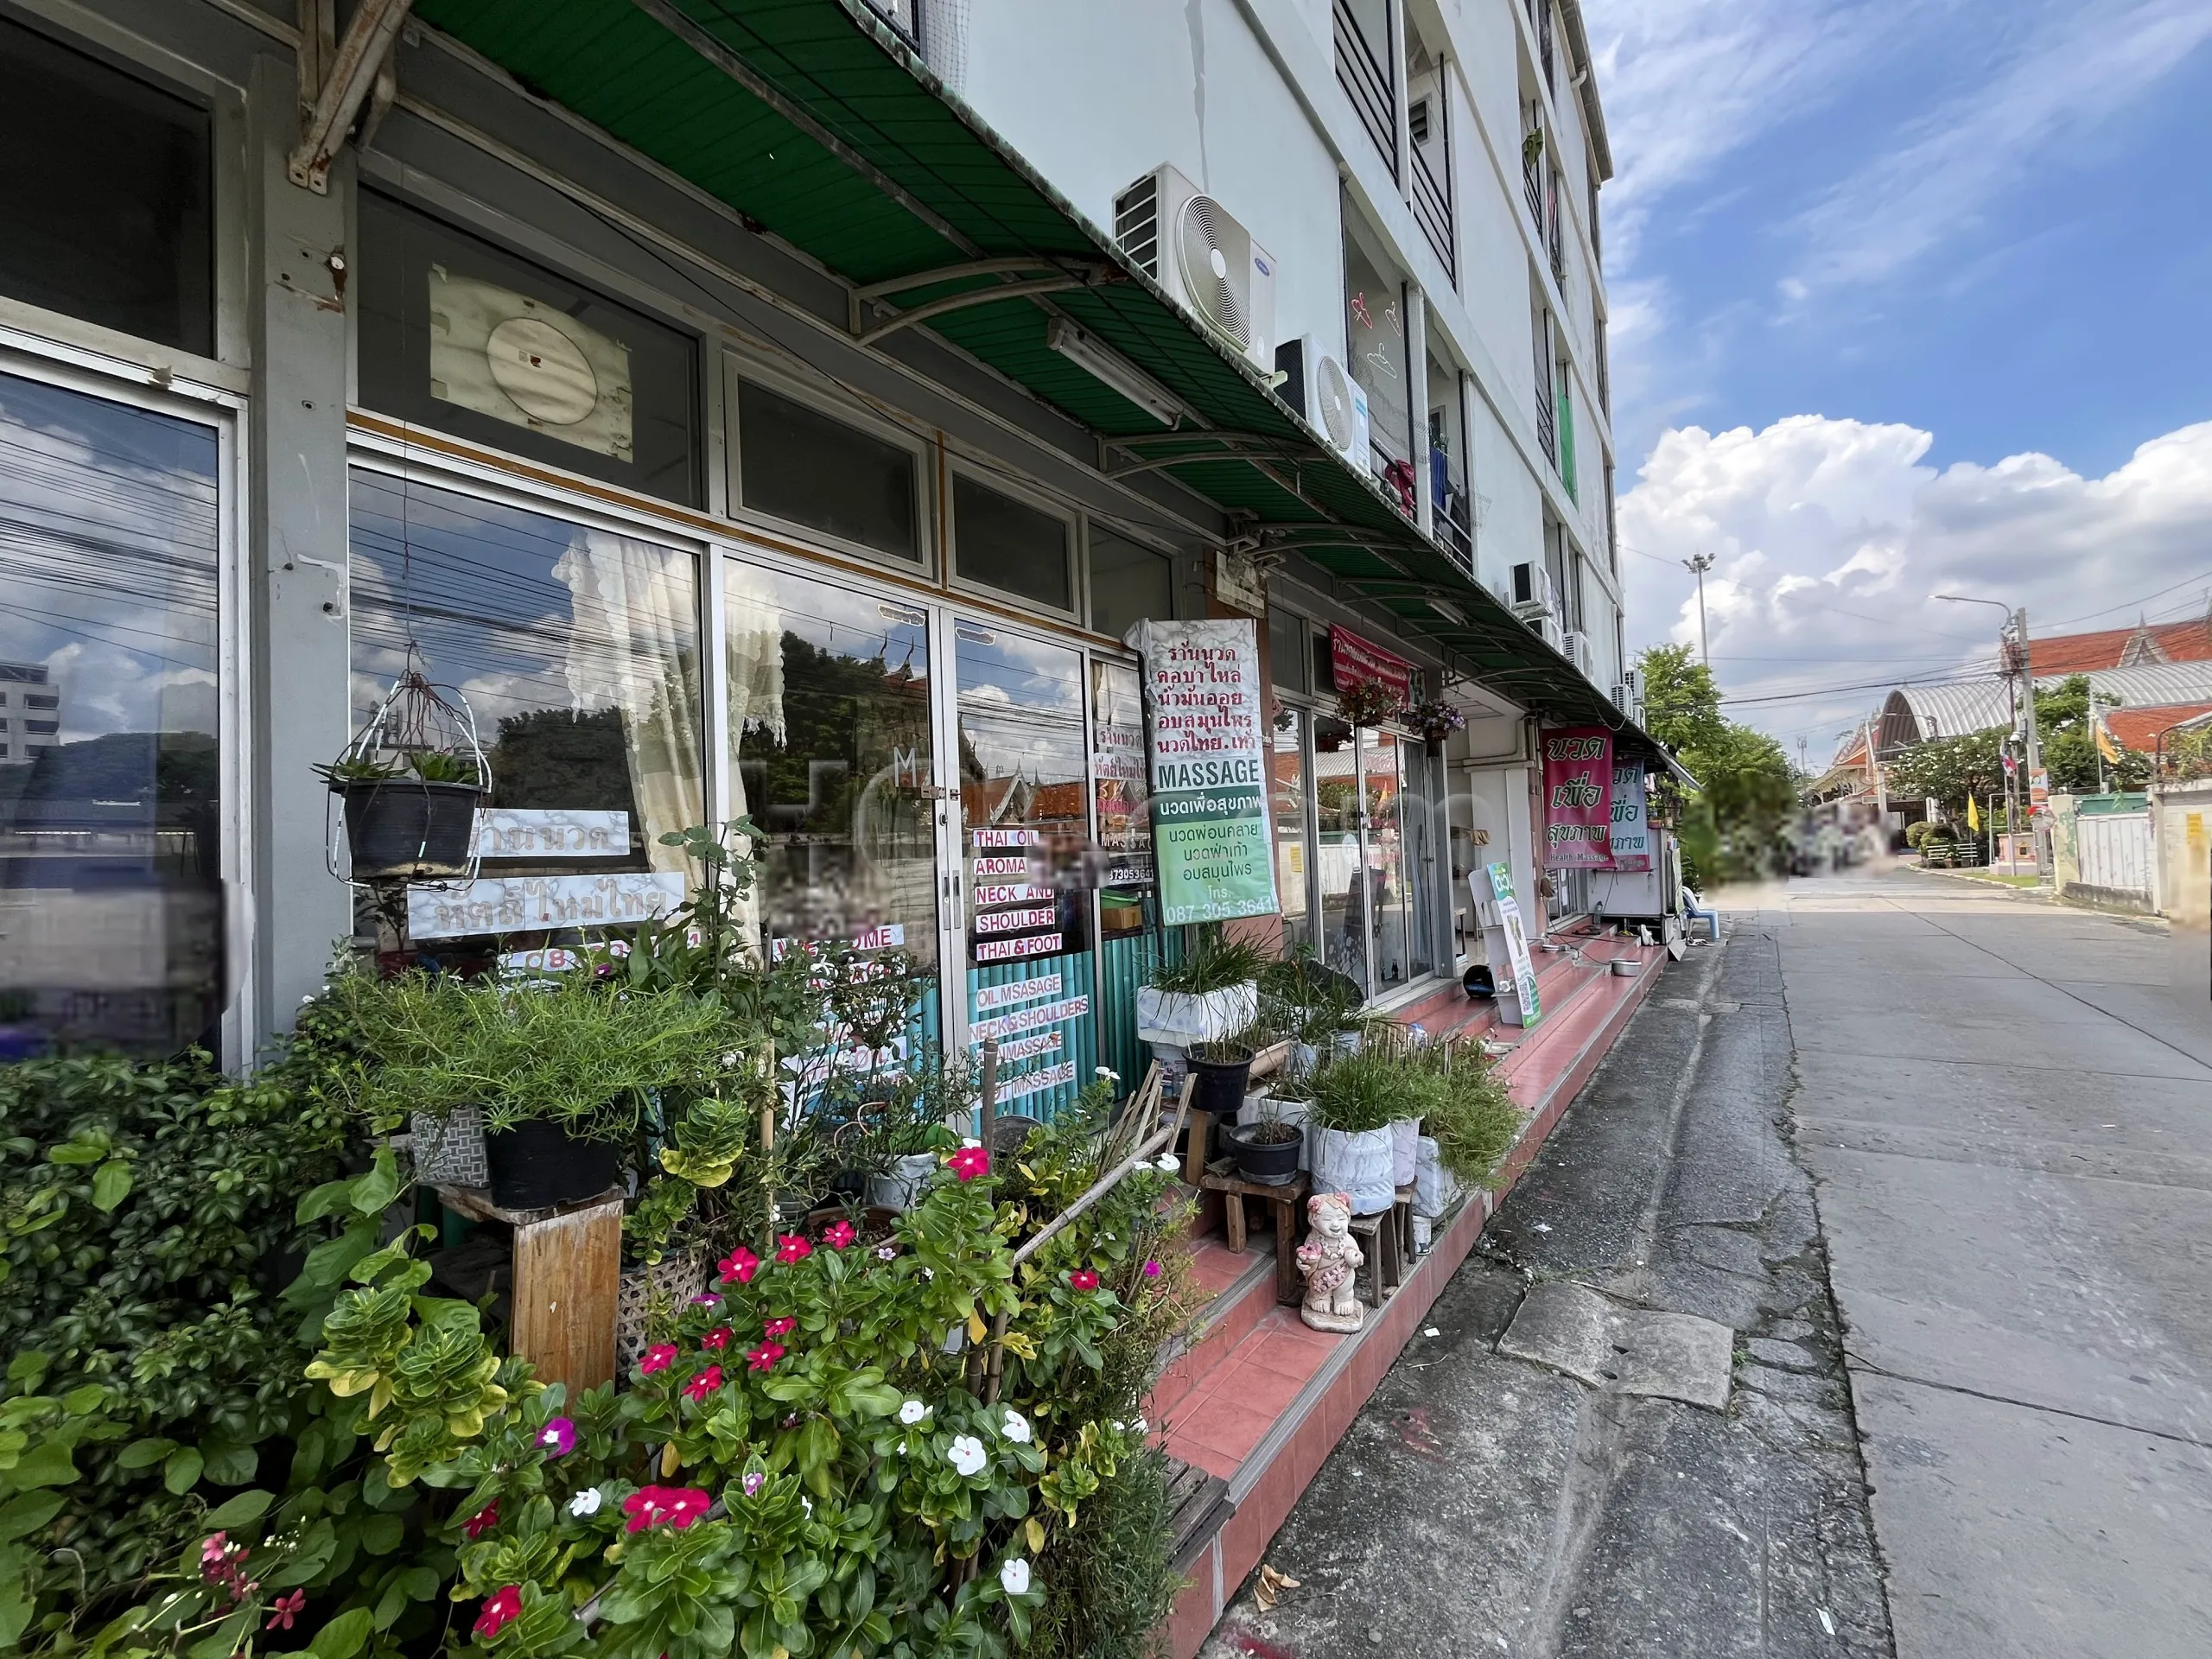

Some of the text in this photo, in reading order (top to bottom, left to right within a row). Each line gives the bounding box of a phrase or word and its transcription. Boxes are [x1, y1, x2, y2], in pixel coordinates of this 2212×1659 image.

[1168, 640, 1236, 661] ร้านนวด
[1159, 704, 1252, 734] อบสมุนไพร
[1547, 736, 1606, 761] นวด
[1158, 760, 1259, 789] MASSAGE
[1611, 766, 1639, 785] วด
[1551, 770, 1603, 808] เพื่อ
[1160, 791, 1261, 816] นวดเพื่อสุขภาพ
[1611, 795, 1639, 823] พื่อ
[976, 830, 1038, 847] THAI OIL
[1169, 824, 1258, 842] นวดผ่อนคลาย
[1547, 823, 1607, 849] สุขภาพ
[1184, 841, 1248, 861] นวดฝ่าเท้า
[976, 858, 1027, 874] AROMA
[1183, 861, 1252, 882] อบสมุนไพร
[976, 887, 1018, 904] NECK
[1166, 896, 1274, 923] 087 305 3641
[980, 910, 1054, 931] SHOULDER
[977, 989, 1000, 1008] OIL
